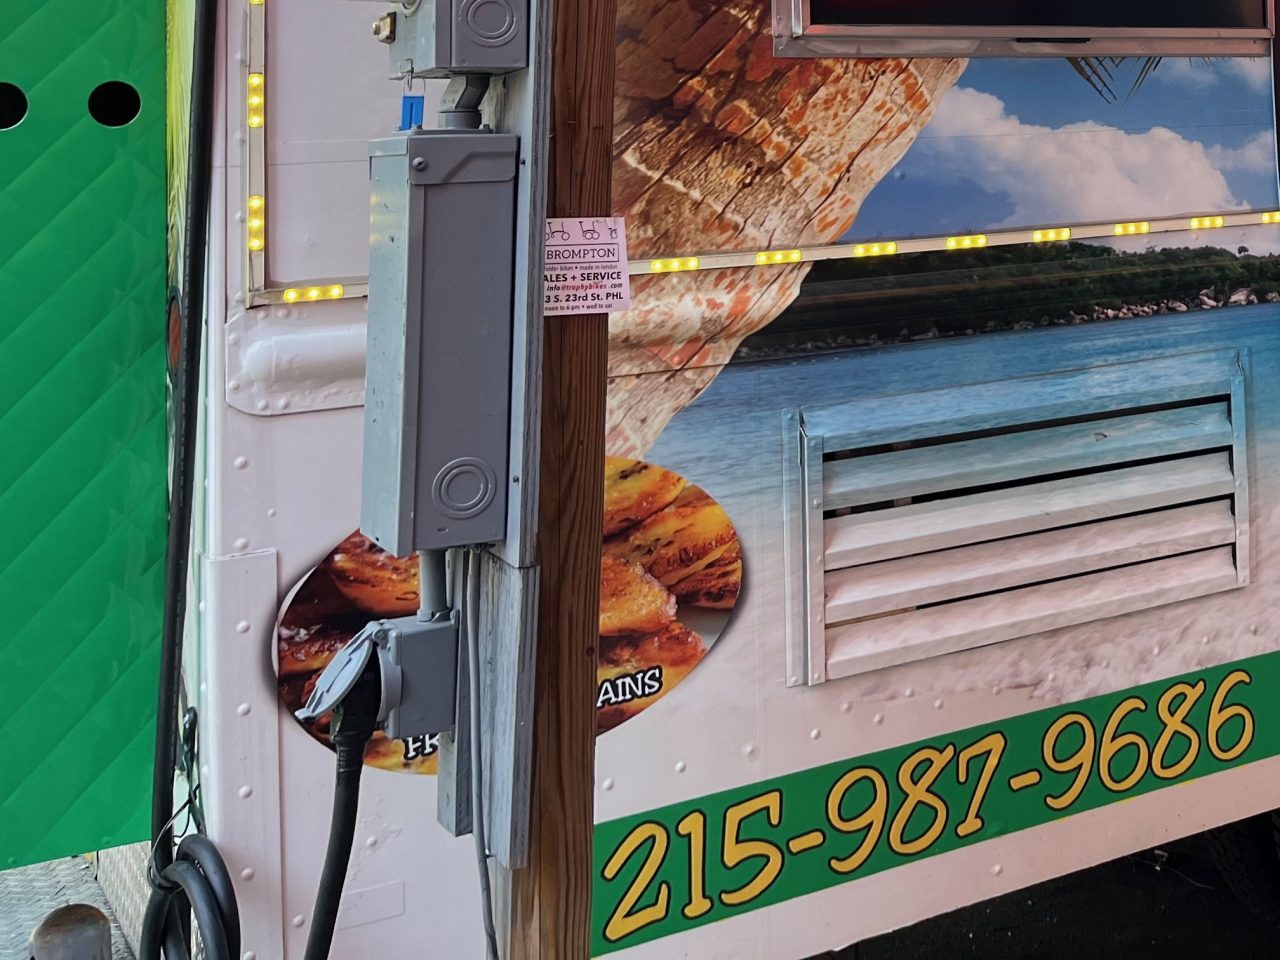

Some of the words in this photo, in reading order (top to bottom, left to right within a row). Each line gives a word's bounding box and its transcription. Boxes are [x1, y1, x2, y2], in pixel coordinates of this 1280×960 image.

[546, 248, 615, 259] BROMPTON
[580, 272, 621, 280] SERVICE
[565, 294, 588, 302] 23rd
[591, 293, 603, 301] St.
[606, 292, 623, 300] PHL
[601, 669, 1255, 941] 215-987-9686
